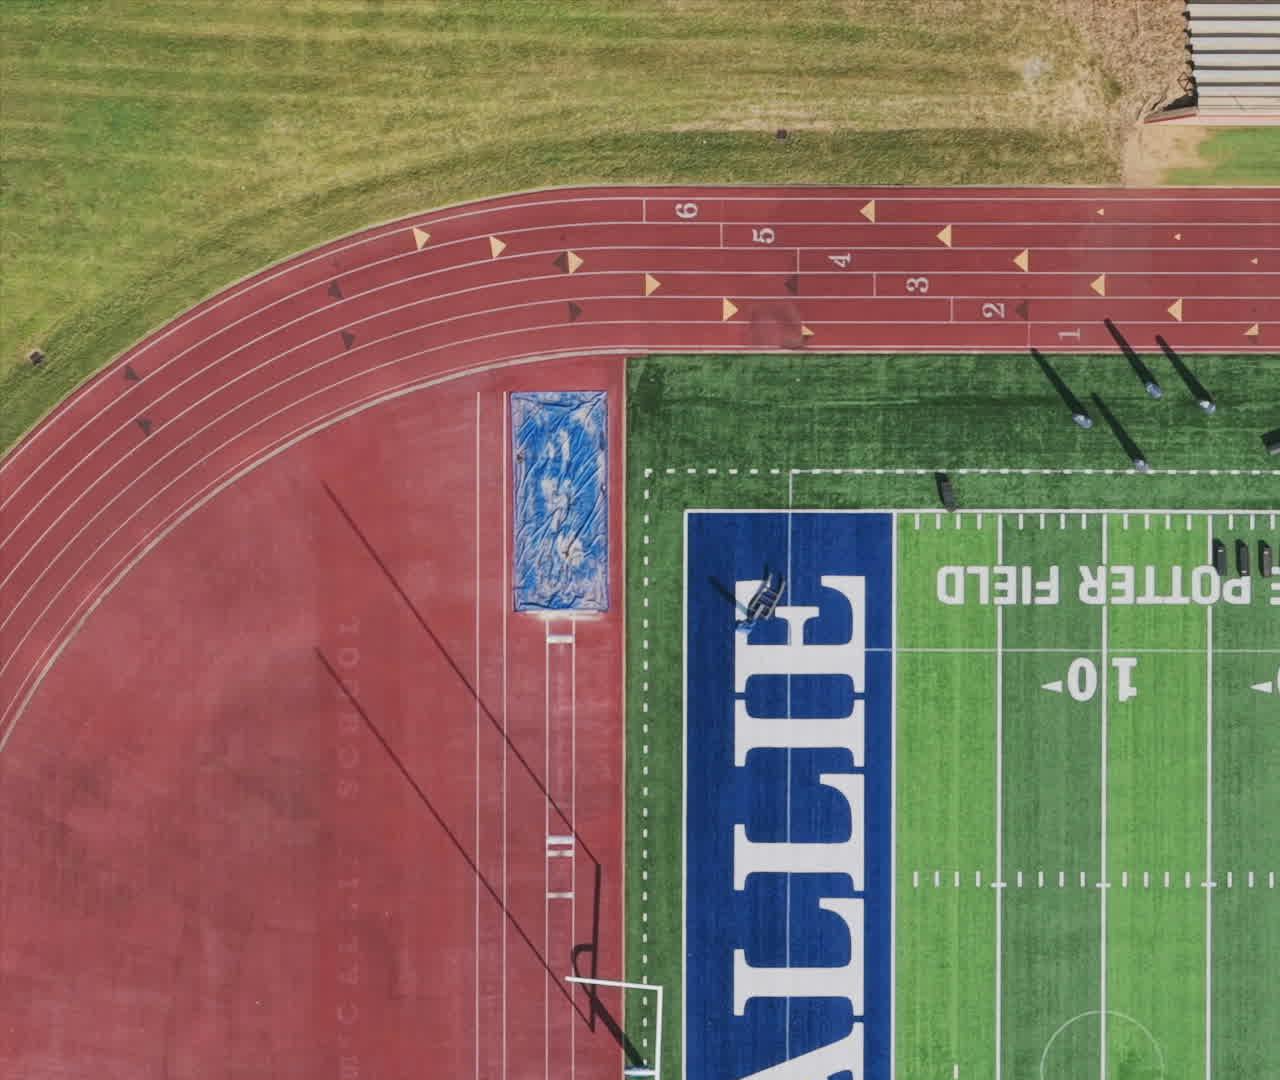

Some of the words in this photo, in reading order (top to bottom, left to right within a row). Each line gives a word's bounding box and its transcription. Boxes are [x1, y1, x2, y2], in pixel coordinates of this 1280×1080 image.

[676, 203, 698, 219] 6
[752, 227, 775, 244] 5
[828, 253, 851, 268] 4
[906, 277, 928, 293] 3
[982, 302, 1005, 318] 2
[1058, 328, 1081, 341] 1
[936, 565, 1060, 605] FIELD
[1078, 565, 1252, 605] POTTER
[1067, 657, 1138, 702] 10
